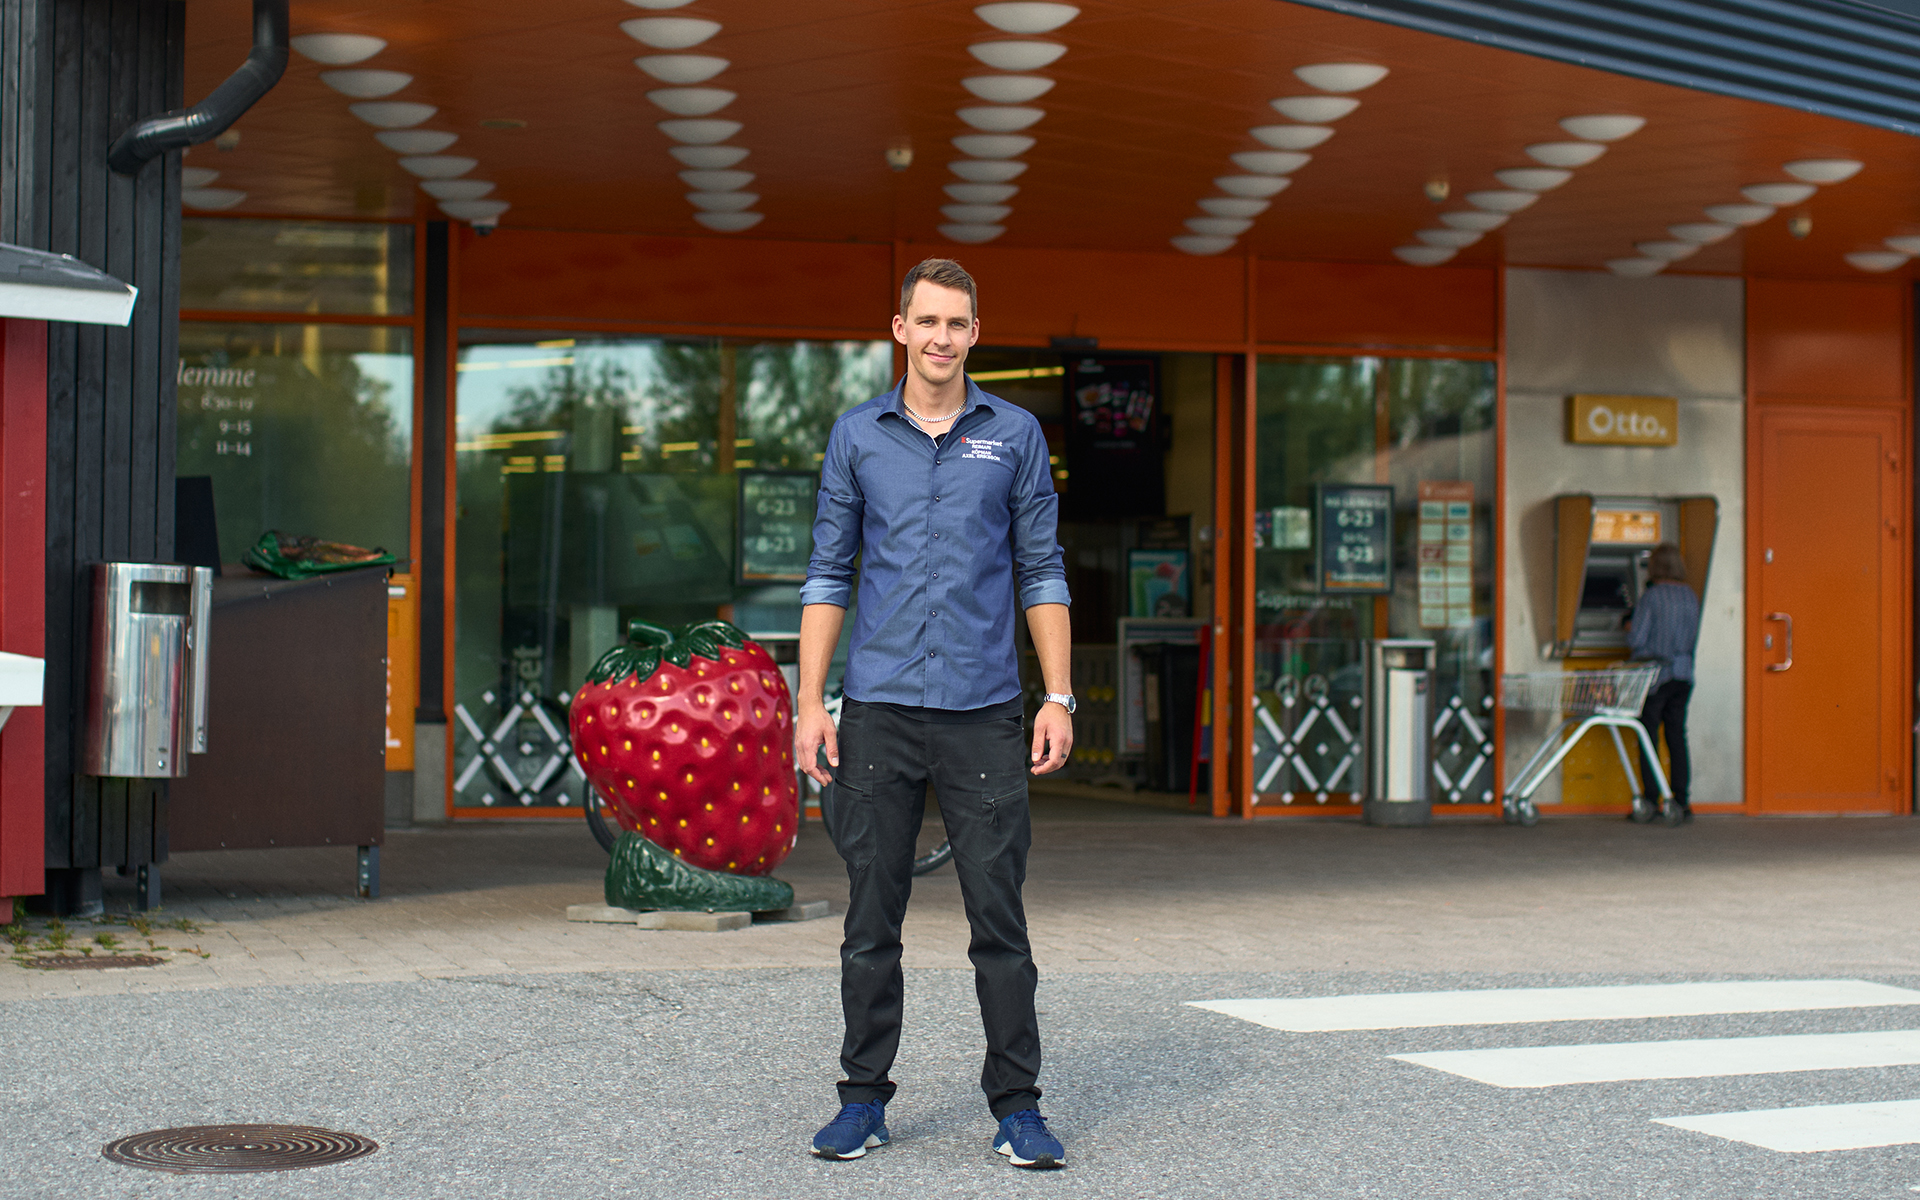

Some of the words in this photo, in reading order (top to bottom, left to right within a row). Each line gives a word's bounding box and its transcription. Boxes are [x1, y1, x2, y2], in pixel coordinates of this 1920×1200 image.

[219, 420, 252, 436] 9-15
[1588, 405, 1667, 438] Otto.
[216, 441, 251, 456] 11-14
[966, 438, 1002, 447] Supermarket
[756, 500, 796, 515] 6-23
[1337, 510, 1374, 527] 6-23
[1337, 546, 1374, 563] 8-23
[1256, 590, 1352, 610] Supermarket
